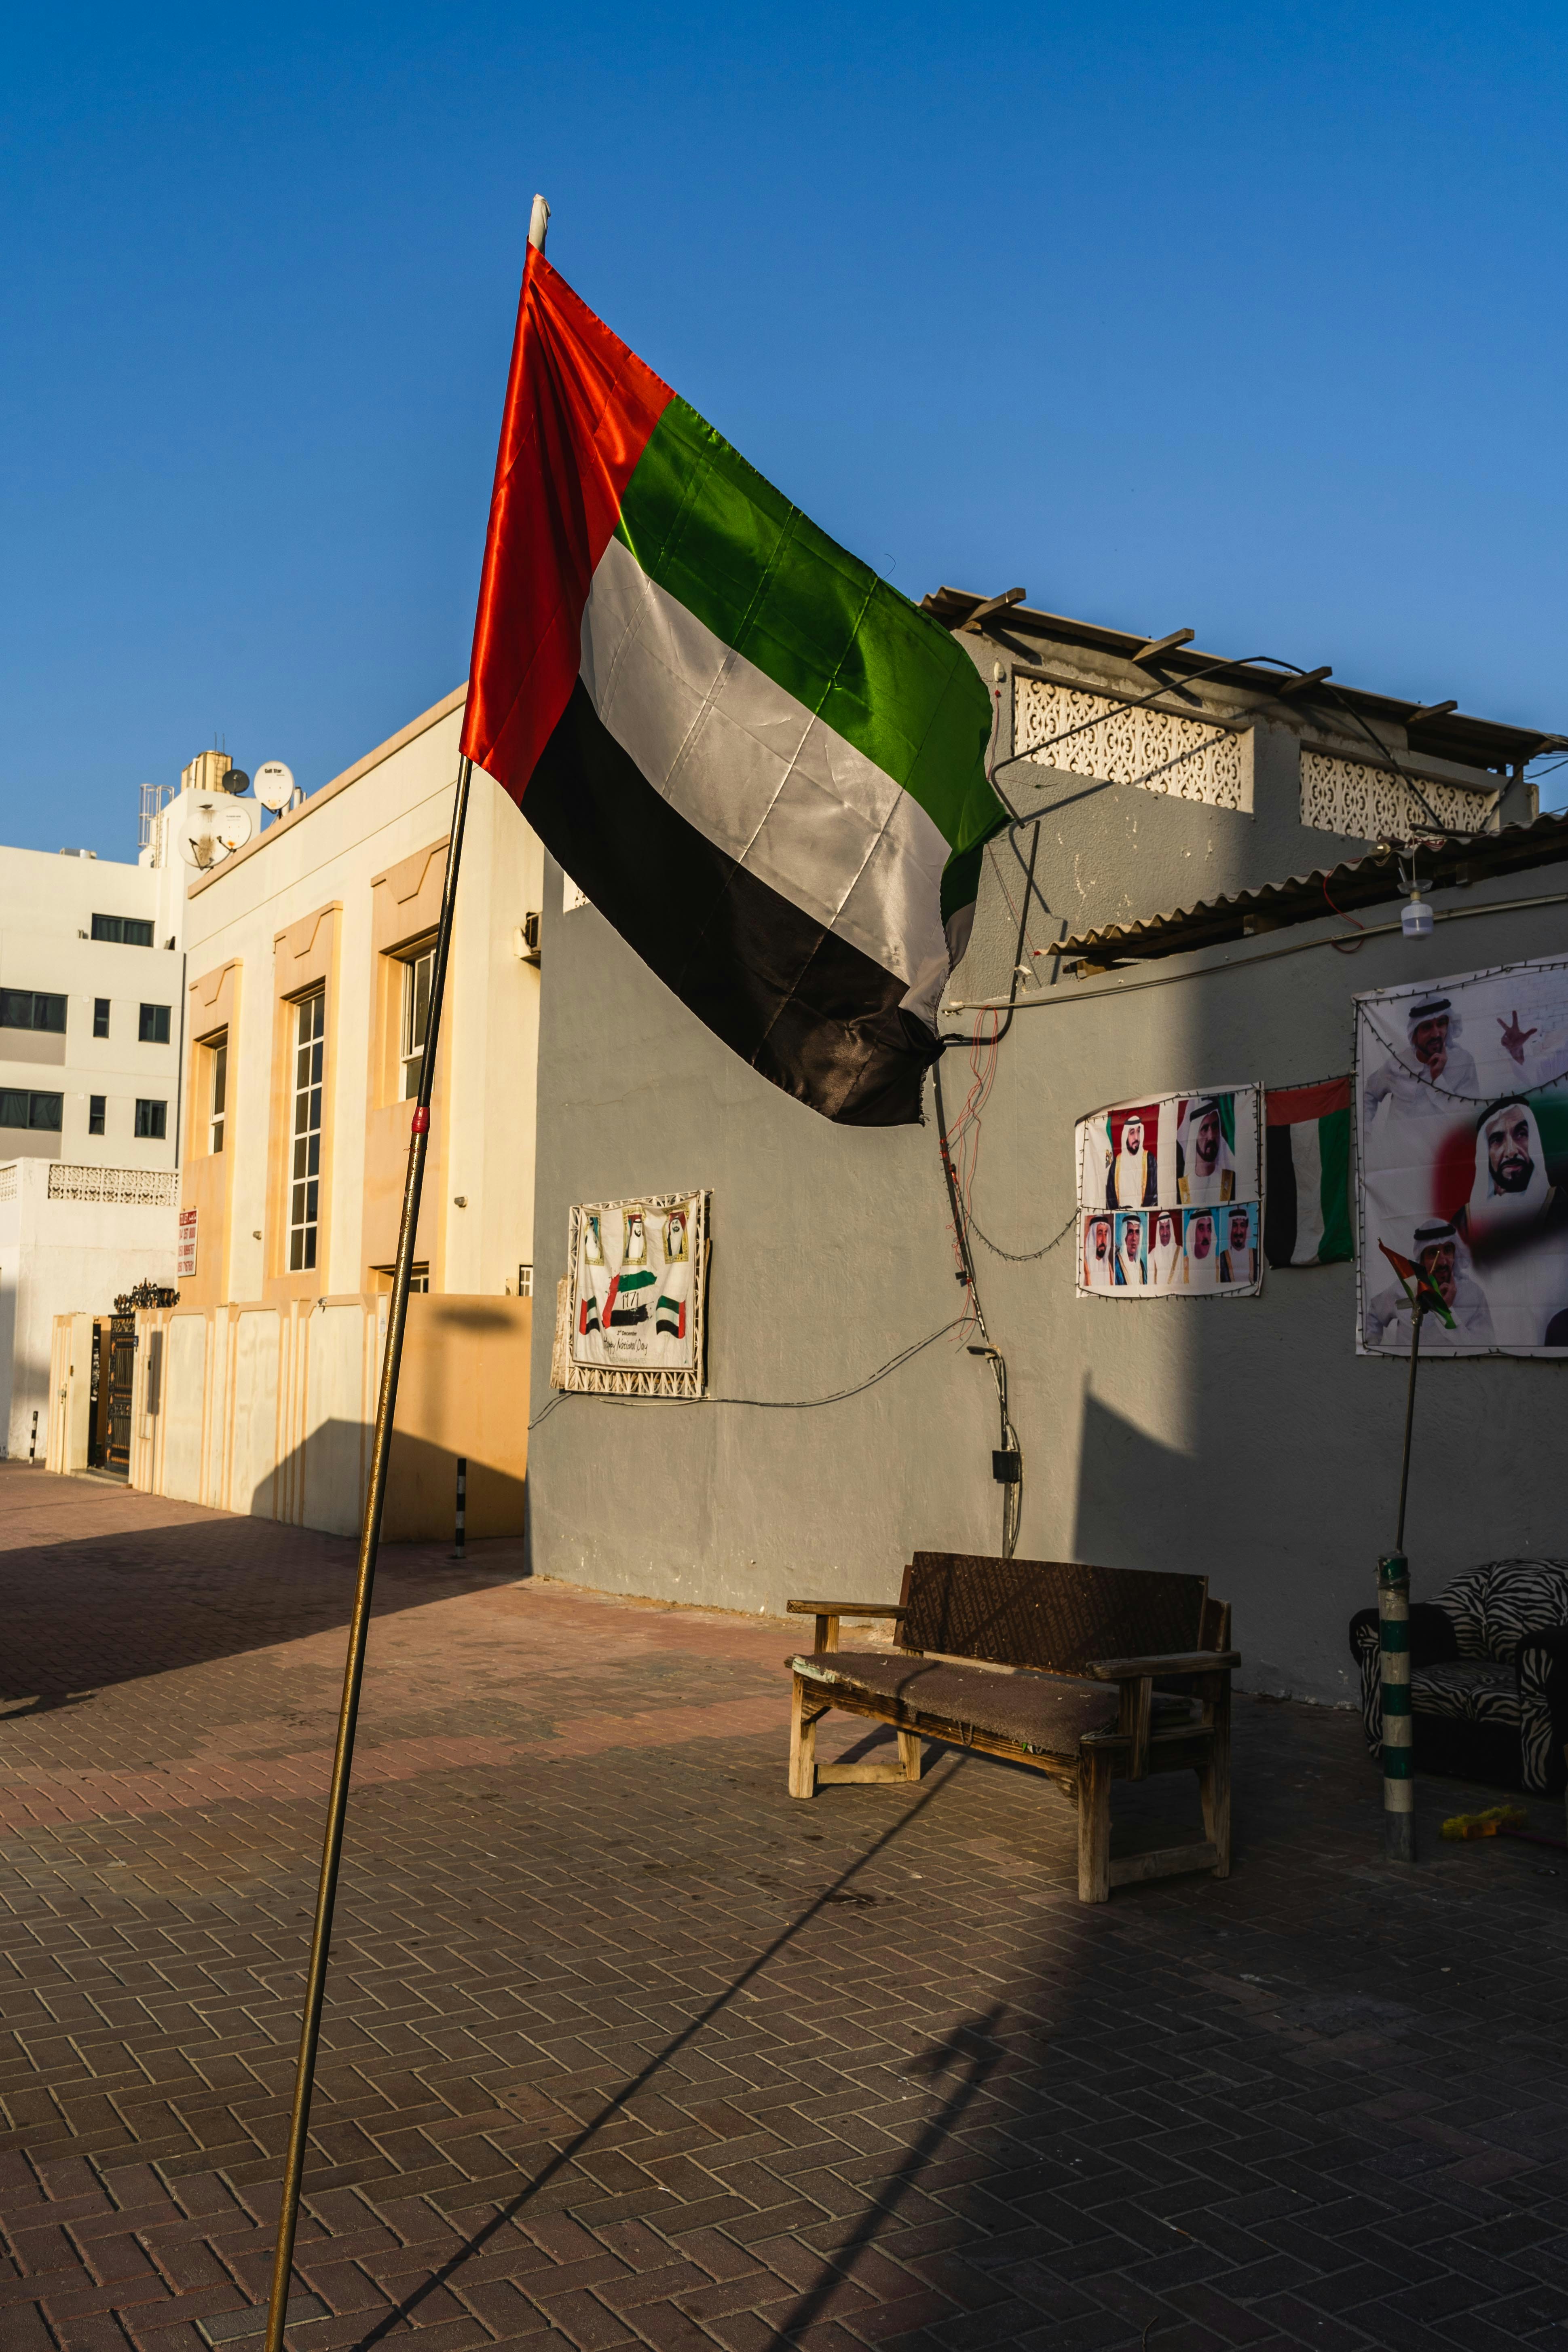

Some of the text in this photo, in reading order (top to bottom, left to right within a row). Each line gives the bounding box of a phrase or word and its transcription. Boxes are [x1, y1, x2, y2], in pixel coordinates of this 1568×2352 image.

[621, 1291, 639, 1309] 1971
[617, 1338, 637, 1351] National
[636, 1338, 648, 1355] Day
